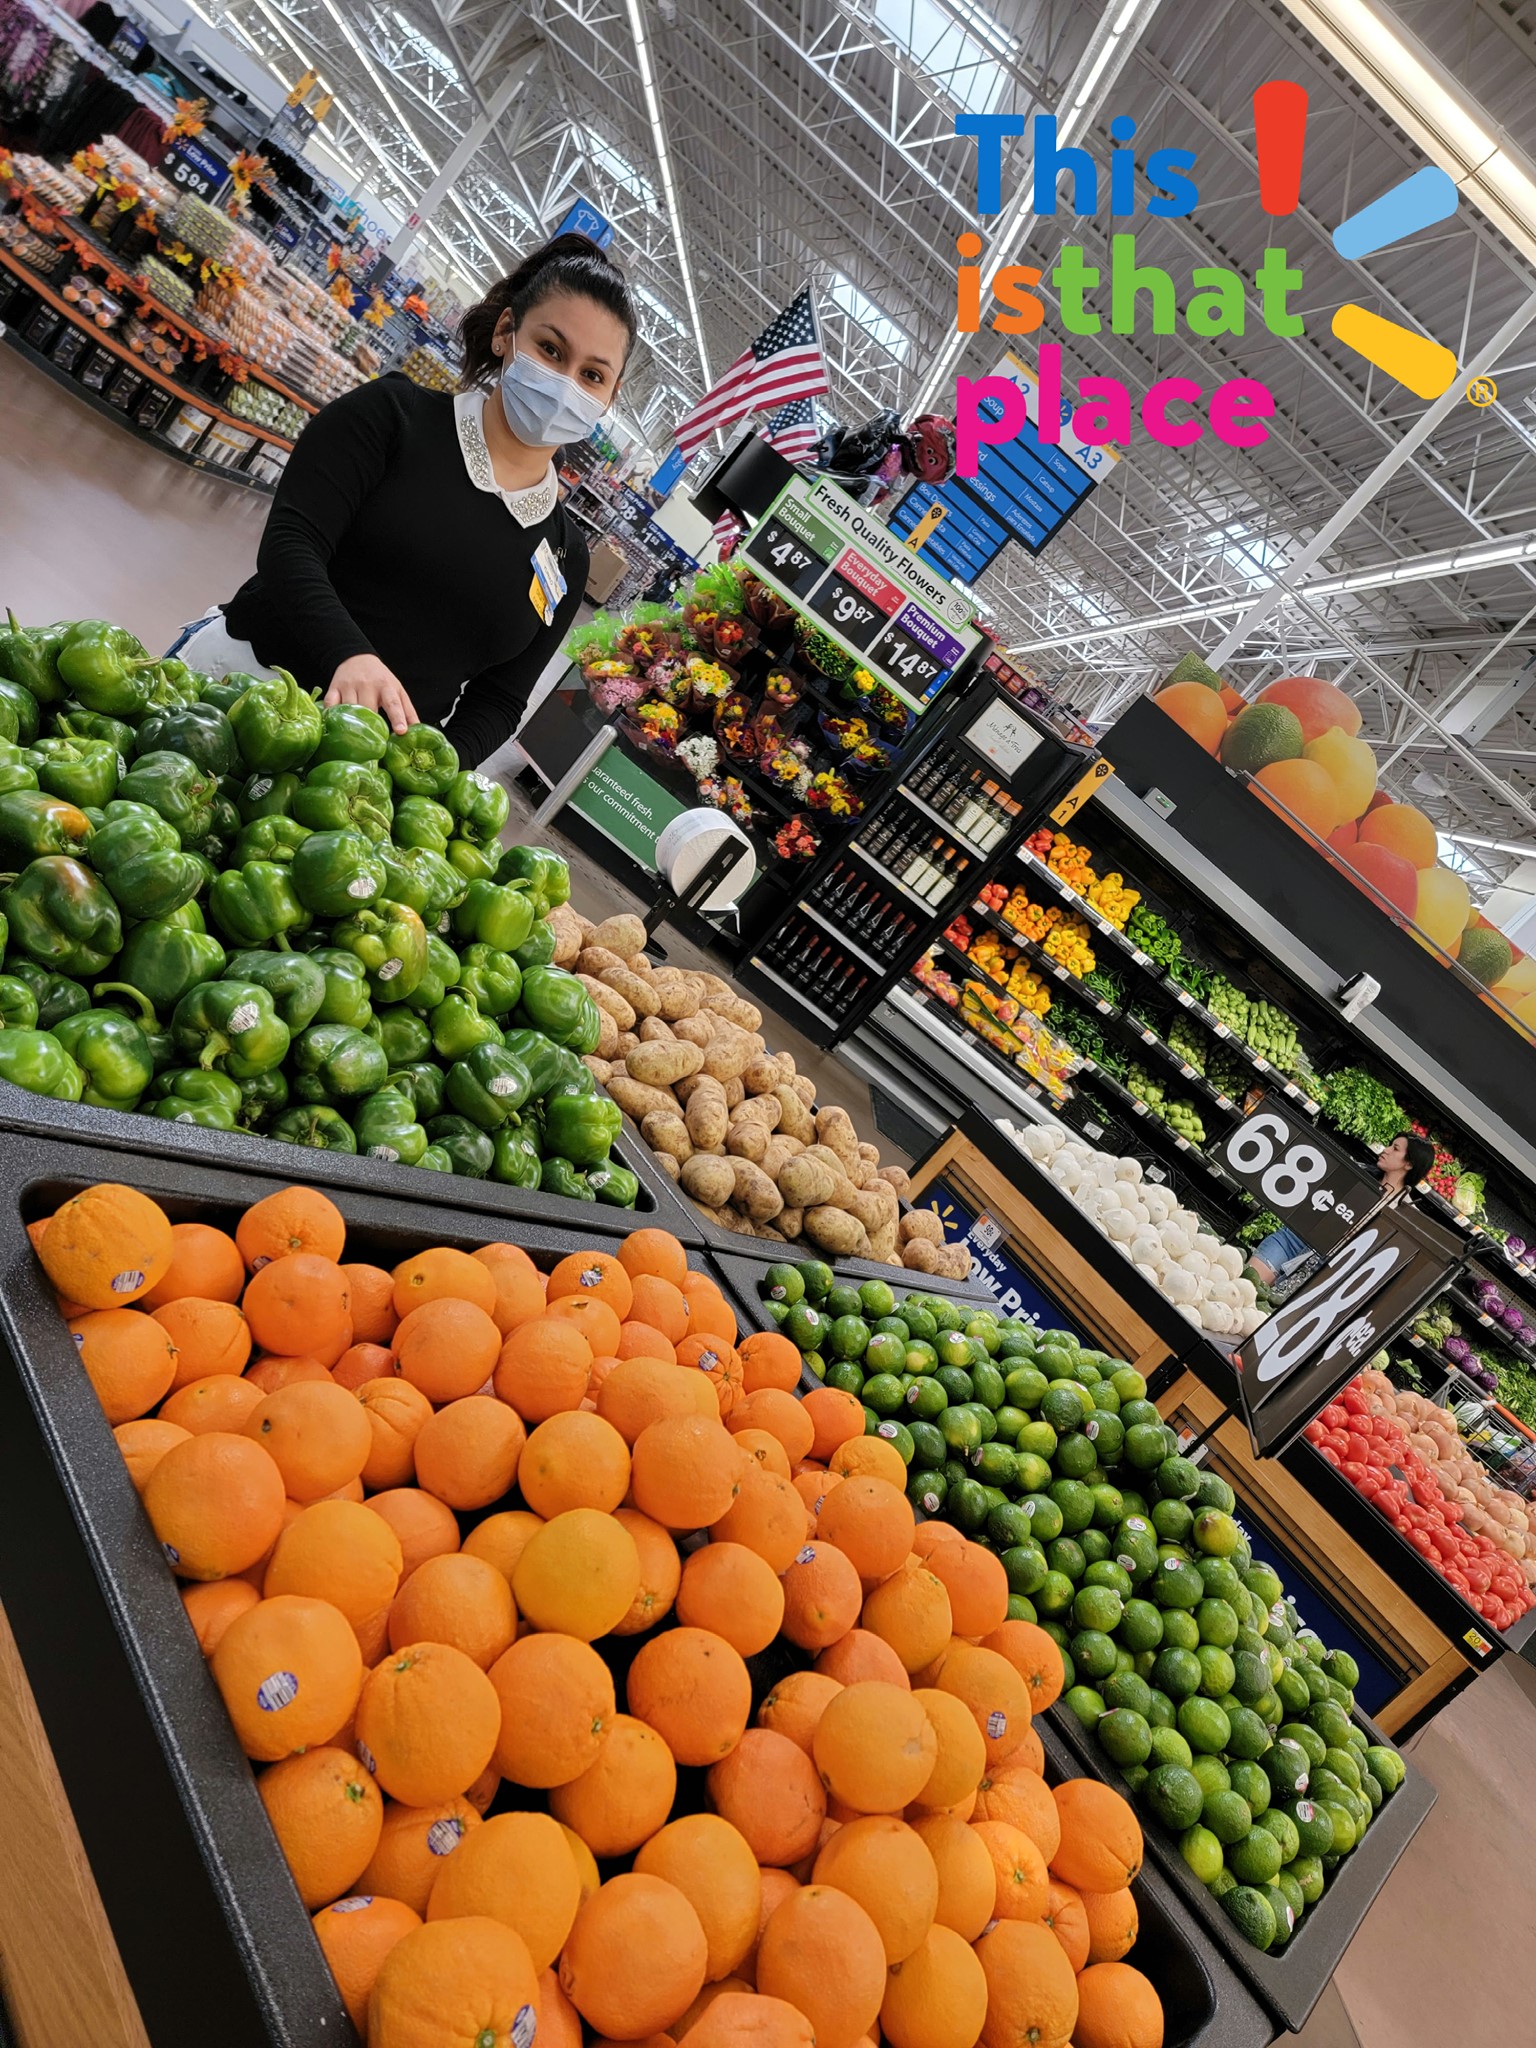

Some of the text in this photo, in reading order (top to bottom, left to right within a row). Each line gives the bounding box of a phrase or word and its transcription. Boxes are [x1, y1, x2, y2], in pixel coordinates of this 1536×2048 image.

[1075, 445, 1103, 469] A3
[919, 484, 932, 498] Box
[778, 507, 816, 543] Bouquet
[785, 498, 809, 523] Small
[813, 484, 850, 522] Fresh
[851, 516, 899, 564] Quality
[896, 556, 947, 606] Flowers
[908, 537, 919, 548] A
[840, 561, 879, 598] Bouquet
[846, 552, 888, 590] Everyday
[900, 613, 939, 649] Bouquet
[907, 604, 946, 642] Premium
[588, 781, 605, 796] our
[603, 794, 656, 840] commitment
[631, 797, 653, 820] fresh.
[1058, 810, 1067, 820] 1
[1066, 796, 1079, 810] A
[1335, 1203, 1354, 1226] ea.
[967, 1230, 1008, 1273] Everyday
